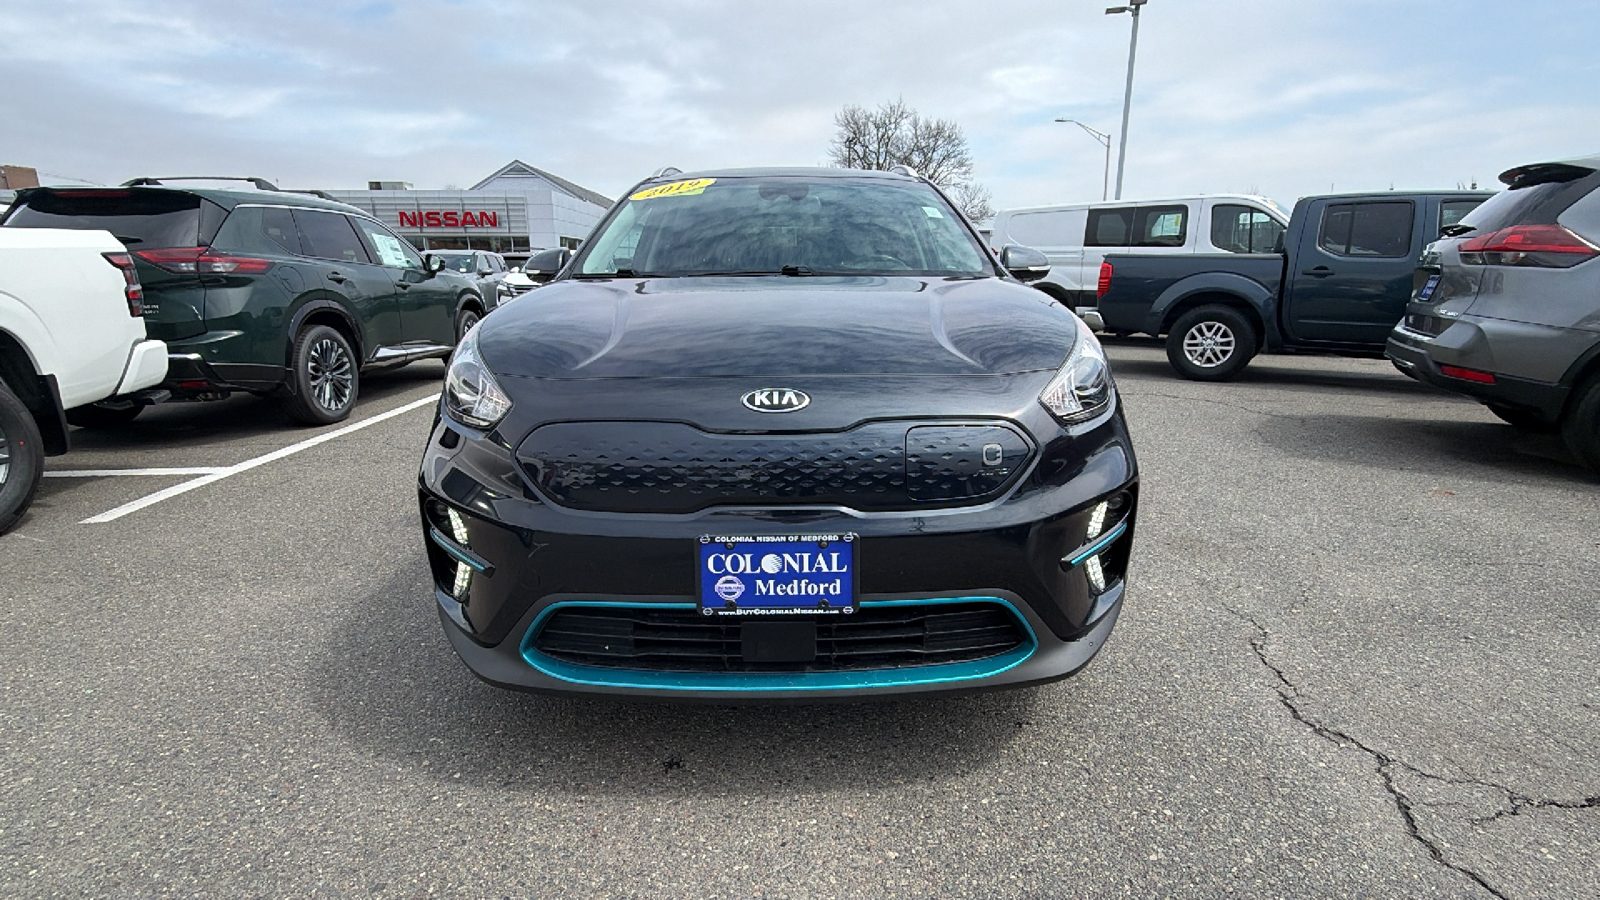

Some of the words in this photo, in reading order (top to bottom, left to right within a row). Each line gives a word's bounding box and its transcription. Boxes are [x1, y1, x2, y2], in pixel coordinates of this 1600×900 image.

[646, 180, 701, 197] 2019
[399, 211, 498, 227] NISSAN
[754, 391, 799, 406] KIA
[714, 535, 755, 543] COLONIAL
[756, 535, 787, 543] NISSAN
[800, 534, 839, 542] MEDFORD
[707, 552, 848, 575] COLONIAL
[754, 578, 842, 596] Medford
